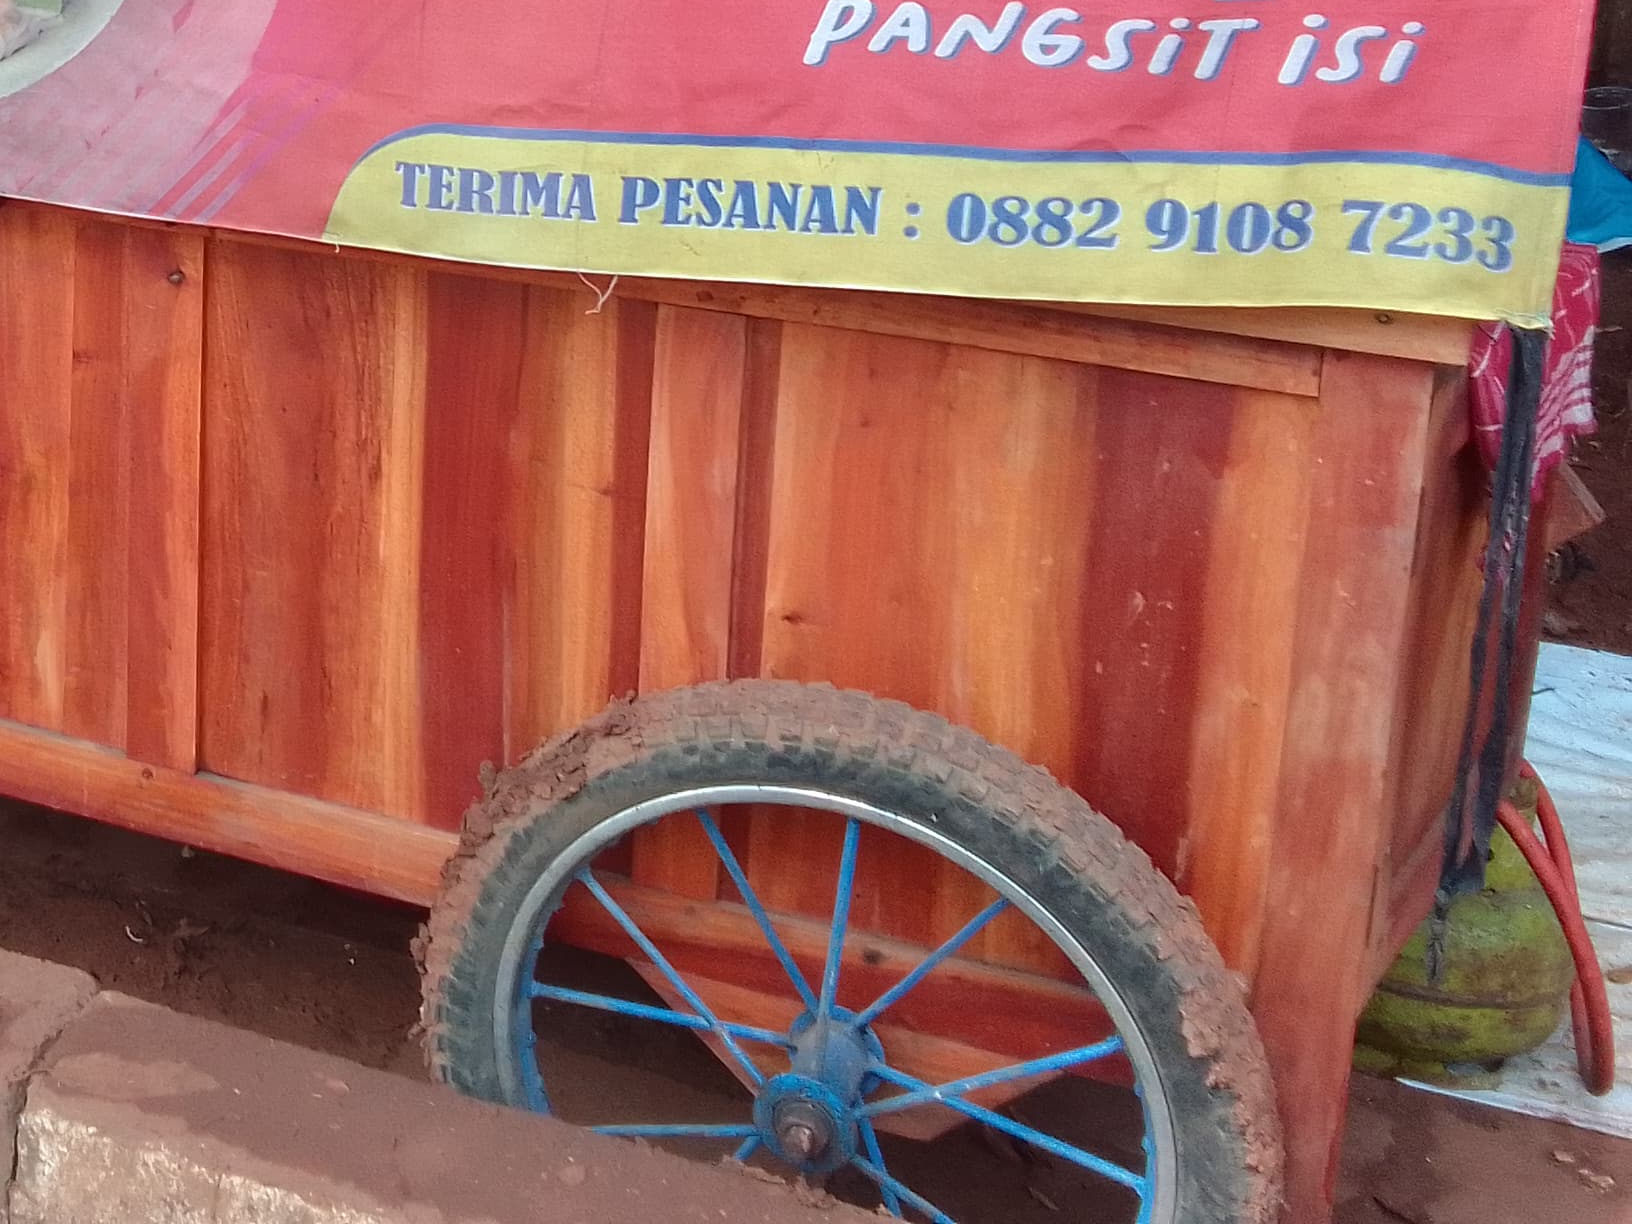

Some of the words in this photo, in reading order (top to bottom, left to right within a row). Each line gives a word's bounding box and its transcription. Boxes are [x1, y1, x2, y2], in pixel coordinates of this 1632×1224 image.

[395, 160, 597, 224] TERIMA
[618, 175, 882, 237] PESANAN
[946, 192, 1122, 250] 0882
[1145, 199, 1314, 253] 9108
[1340, 199, 1516, 273] 7233
